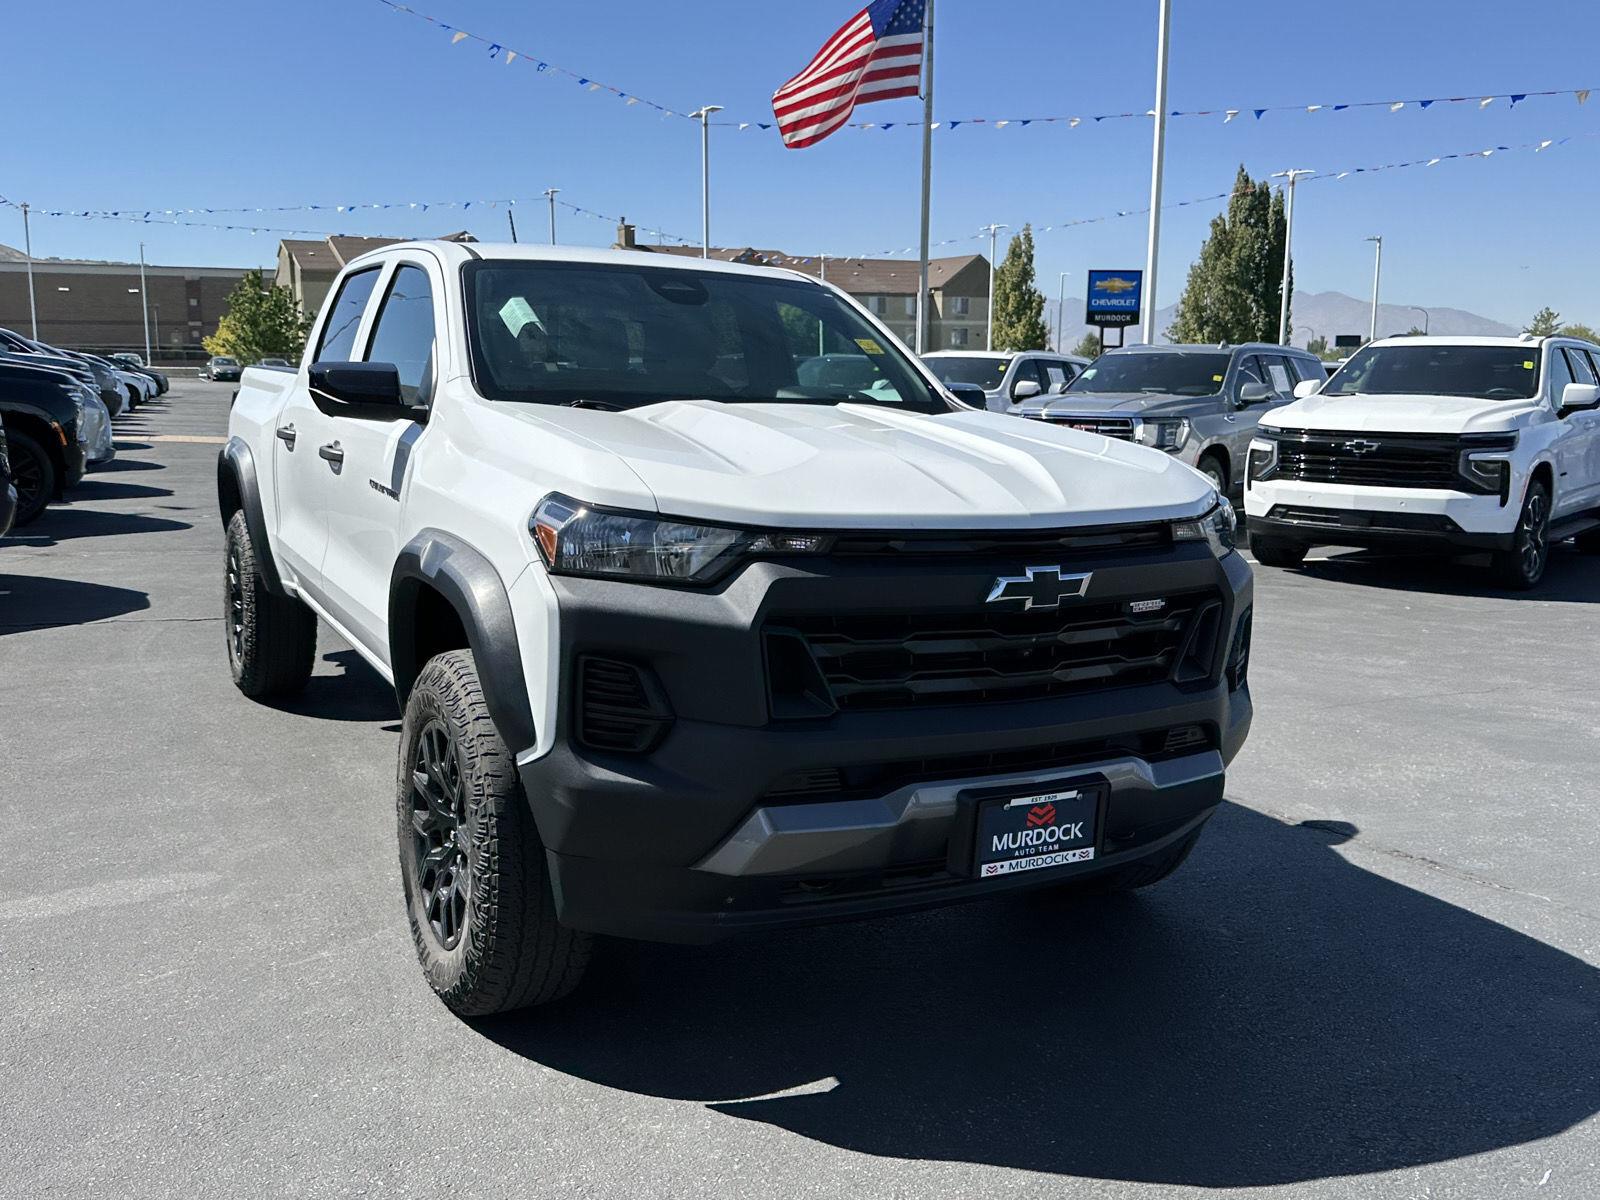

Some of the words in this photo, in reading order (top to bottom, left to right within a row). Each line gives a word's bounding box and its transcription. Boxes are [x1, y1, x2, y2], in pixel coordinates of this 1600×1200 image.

[992, 822, 1084, 851] MURDOCK
[1014, 847, 1036, 856] AUTO
[1039, 843, 1060, 853] TEAM
[1008, 852, 1070, 871] MURDOCK
